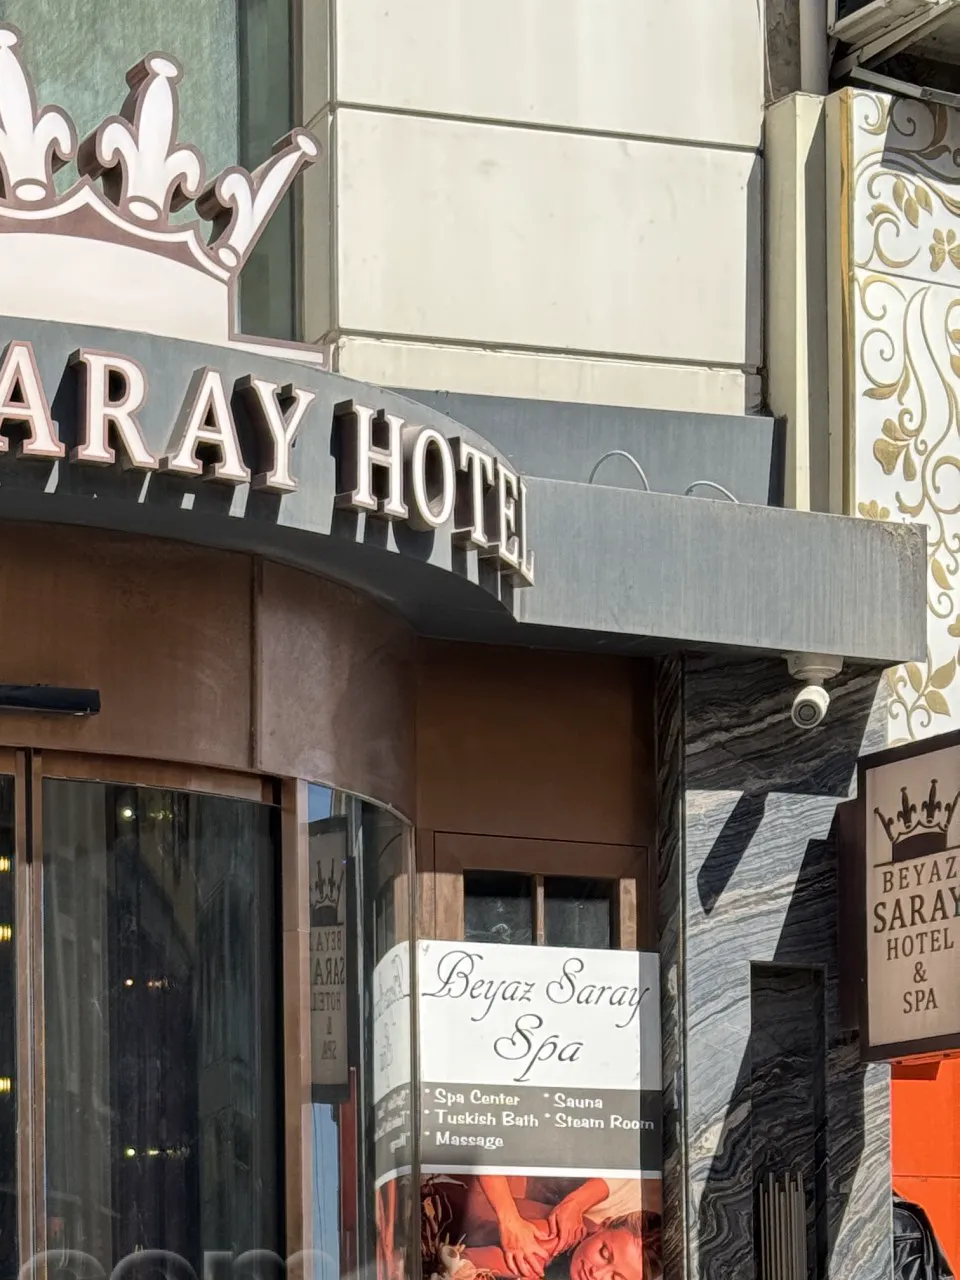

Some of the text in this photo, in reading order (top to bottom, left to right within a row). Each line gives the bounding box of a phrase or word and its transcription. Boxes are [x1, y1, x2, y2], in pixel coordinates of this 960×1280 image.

[336, 399, 535, 587] HOTEL
[882, 856, 958, 894] BEYAZ
[873, 885, 960, 934] SARAY
[886, 927, 954, 961] HOTEL
[913, 961, 928, 984] &
[422, 950, 536, 1022] Beyaz
[545, 957, 651, 1029] Saray
[903, 987, 938, 1014] SPA
[493, 1013, 584, 1083] Spa
[434, 1087, 521, 1106] Spa Center
[553, 1092, 603, 1109] Sauna
[502, 1111, 539, 1127] Bath
[554, 1112, 655, 1130] Steam Room
[435, 1131, 505, 1150] Massage
